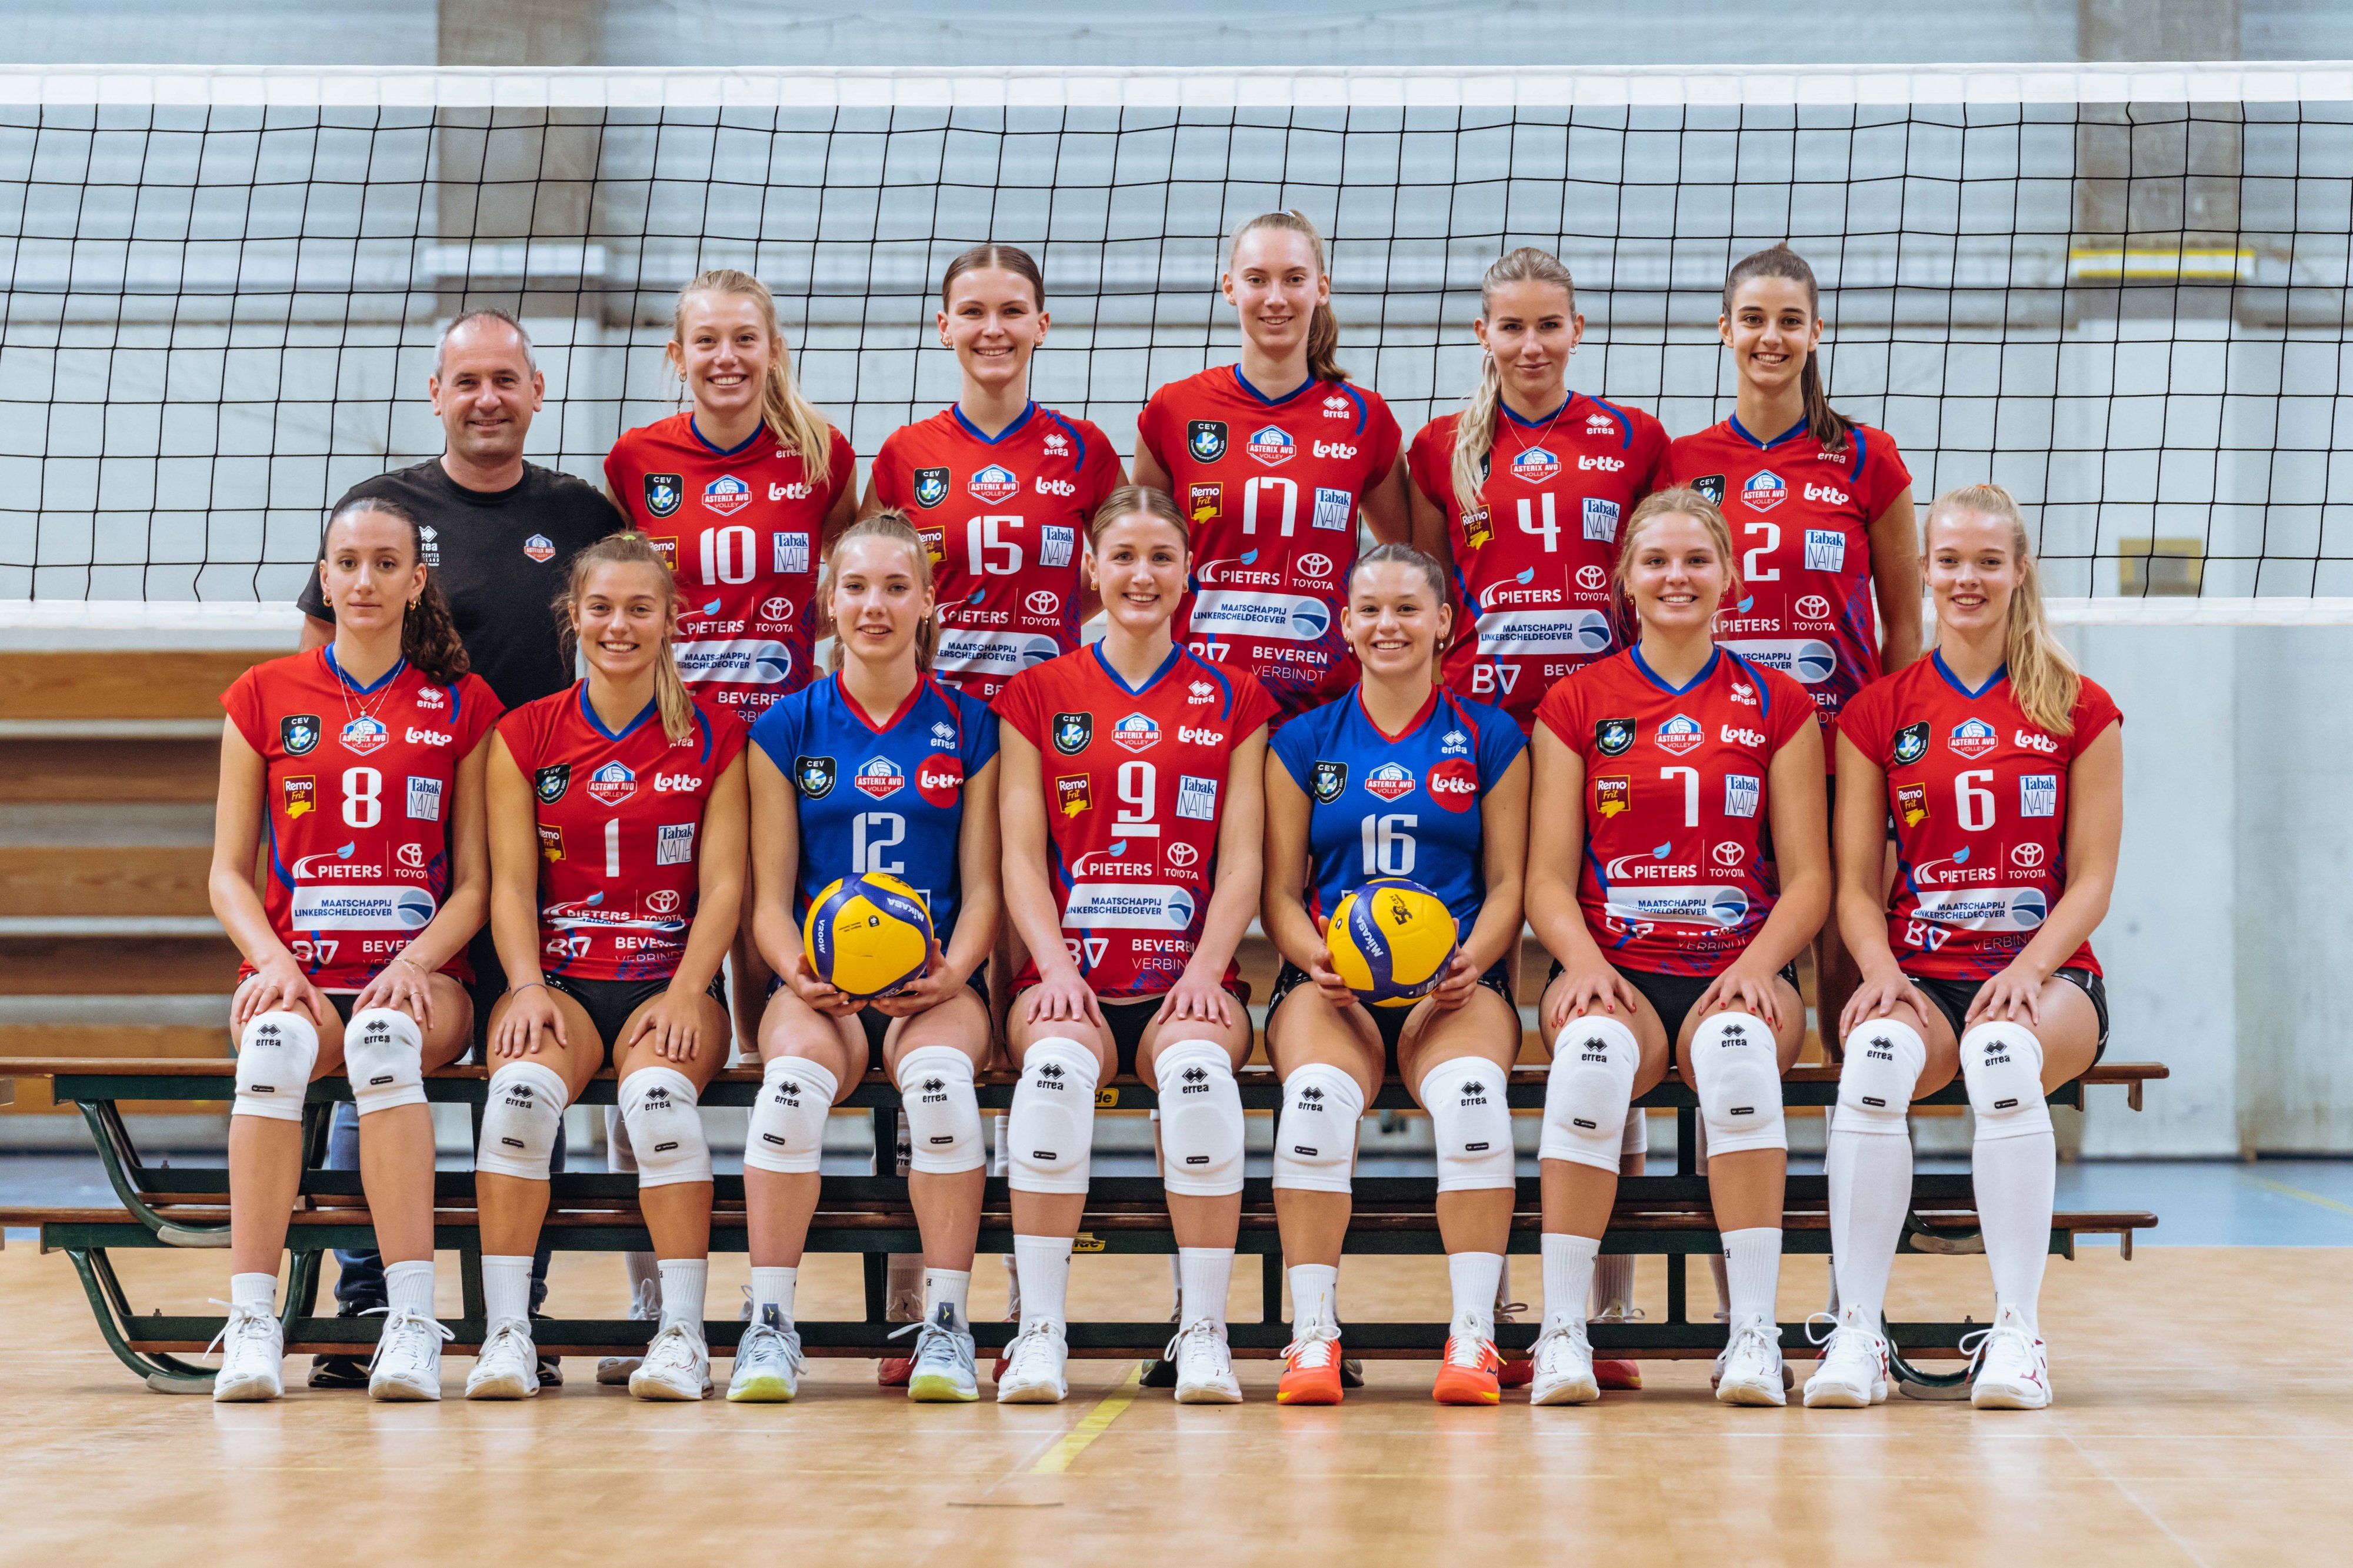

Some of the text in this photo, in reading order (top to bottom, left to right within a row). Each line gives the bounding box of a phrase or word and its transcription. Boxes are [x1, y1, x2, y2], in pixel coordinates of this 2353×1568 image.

[1323, 409, 1349, 419] errea
[1044, 448, 1069, 456] errea
[1249, 443, 1279, 453] ASTERIX
[1817, 452, 1846, 464] errea
[1699, 478, 1715, 486] CEV
[705, 493, 749, 503] ASTERIX AVO
[1191, 487, 1220, 498] Remo
[1317, 488, 1350, 506] Tabak
[1744, 489, 1785, 499] ASTERIX AVO
[1196, 495, 1212, 506] Frit
[1242, 476, 1298, 537] 17
[1584, 498, 1619, 518] Tabak
[1315, 502, 1349, 531] NATIE
[1517, 492, 1561, 553] 4
[1468, 519, 1482, 534] Frit
[1043, 525, 1074, 542] Tabak
[1807, 530, 1844, 547] Tabak
[775, 534, 808, 547] Tabak
[966, 515, 1024, 575] 15
[699, 525, 756, 585] 10
[1041, 540, 1073, 566] NATIE
[1743, 522, 1781, 582] 2
[1808, 544, 1844, 572] NATIE
[776, 547, 808, 572] NATIE
[1221, 571, 1281, 586] PIETERS
[1292, 578, 1334, 590] TOYOTA
[1499, 589, 1562, 604] PIETERS
[1574, 592, 1610, 602] TOYOTA
[1221, 603, 1287, 615] MAATSCHAPPIJ
[948, 610, 1009, 624] PIETERS
[1021, 616, 1060, 626] TOYOTA
[1194, 611, 1286, 625] LINKERSCHELDEOEVER
[686, 619, 745, 635] PIETERS
[755, 623, 793, 632] TOYOTA
[1503, 623, 1572, 632] MAATSCHAPPIJ
[1720, 618, 1780, 633] PIETERS
[1792, 622, 1835, 631] TOYOTA
[1481, 632, 1573, 642] LINKERSCHELDEOEVER
[948, 642, 1017, 654] MAATSCHAPPIJ
[684, 652, 751, 661] MAATSCHAPPIJ
[1252, 646, 1328, 665] BEVEREN
[1252, 665, 1326, 682] VERBINDT
[416, 699, 444, 709] errea
[1188, 695, 1215, 705] errea
[291, 717, 309, 725] CEV
[372, 734, 386, 742] AVO
[1657, 734, 1686, 742] ASTERIX
[1951, 738, 1979, 746] ASTERIX
[285, 780, 313, 792] Remo
[409, 777, 441, 795] Tabak
[590, 780, 634, 791] ASTERIX AVO
[857, 777, 902, 786] ASTERIX AVO
[1059, 779, 1087, 791] Remo
[1182, 776, 1216, 795] Tabak
[1598, 780, 1627, 790] Remo
[1727, 775, 1759, 792] Tabak
[2021, 776, 2055, 790] Tabak
[291, 790, 305, 800] Frit
[342, 766, 382, 828] 8
[1067, 789, 1081, 801] Frit
[1117, 760, 1156, 823] 9
[1602, 788, 1618, 800] Frit
[1660, 766, 1699, 827] 7
[1898, 789, 1923, 801] Remo
[410, 792, 439, 820] NATIE
[1179, 792, 1214, 820] NATIE
[1727, 790, 1758, 817] NATIE
[1904, 798, 1918, 811] Frit
[1954, 769, 1996, 832] 6
[2023, 789, 2056, 816] NATIE
[659, 825, 695, 841] Tabak
[605, 818, 619, 878] 1
[852, 812, 906, 874] 12
[1361, 813, 1418, 876] 16
[659, 837, 692, 864] NATIE
[318, 865, 382, 878] PIETERS
[1089, 863, 1152, 876] PIETERS
[1164, 868, 1199, 880] TOYOTA
[1634, 864, 1697, 879] PIETERS
[1709, 868, 1745, 878] TOYOTA
[1939, 867, 1996, 883] PIETERS
[2008, 869, 2046, 879] TOYOTA
[321, 899, 392, 908] MAATSCHAPPIJ
[1091, 897, 1161, 906] MAATSCHAPPIJ
[1638, 899, 1707, 908] MAATSCHAPPIJ
[1937, 901, 2005, 911] MAATSCHAPPIJ
[295, 908, 392, 917] LINKERSCHELDEOEVER
[818, 919, 826, 954] V200W
[256, 1039, 281, 1047] errea
[1581, 1053, 1607, 1063] errea
[1867, 1050, 1892, 1061] errea
[1036, 1080, 1064, 1091] errea
[505, 1097, 532, 1109] errea
[775, 1095, 799, 1108] errea
[1298, 1102, 1323, 1112] errea
